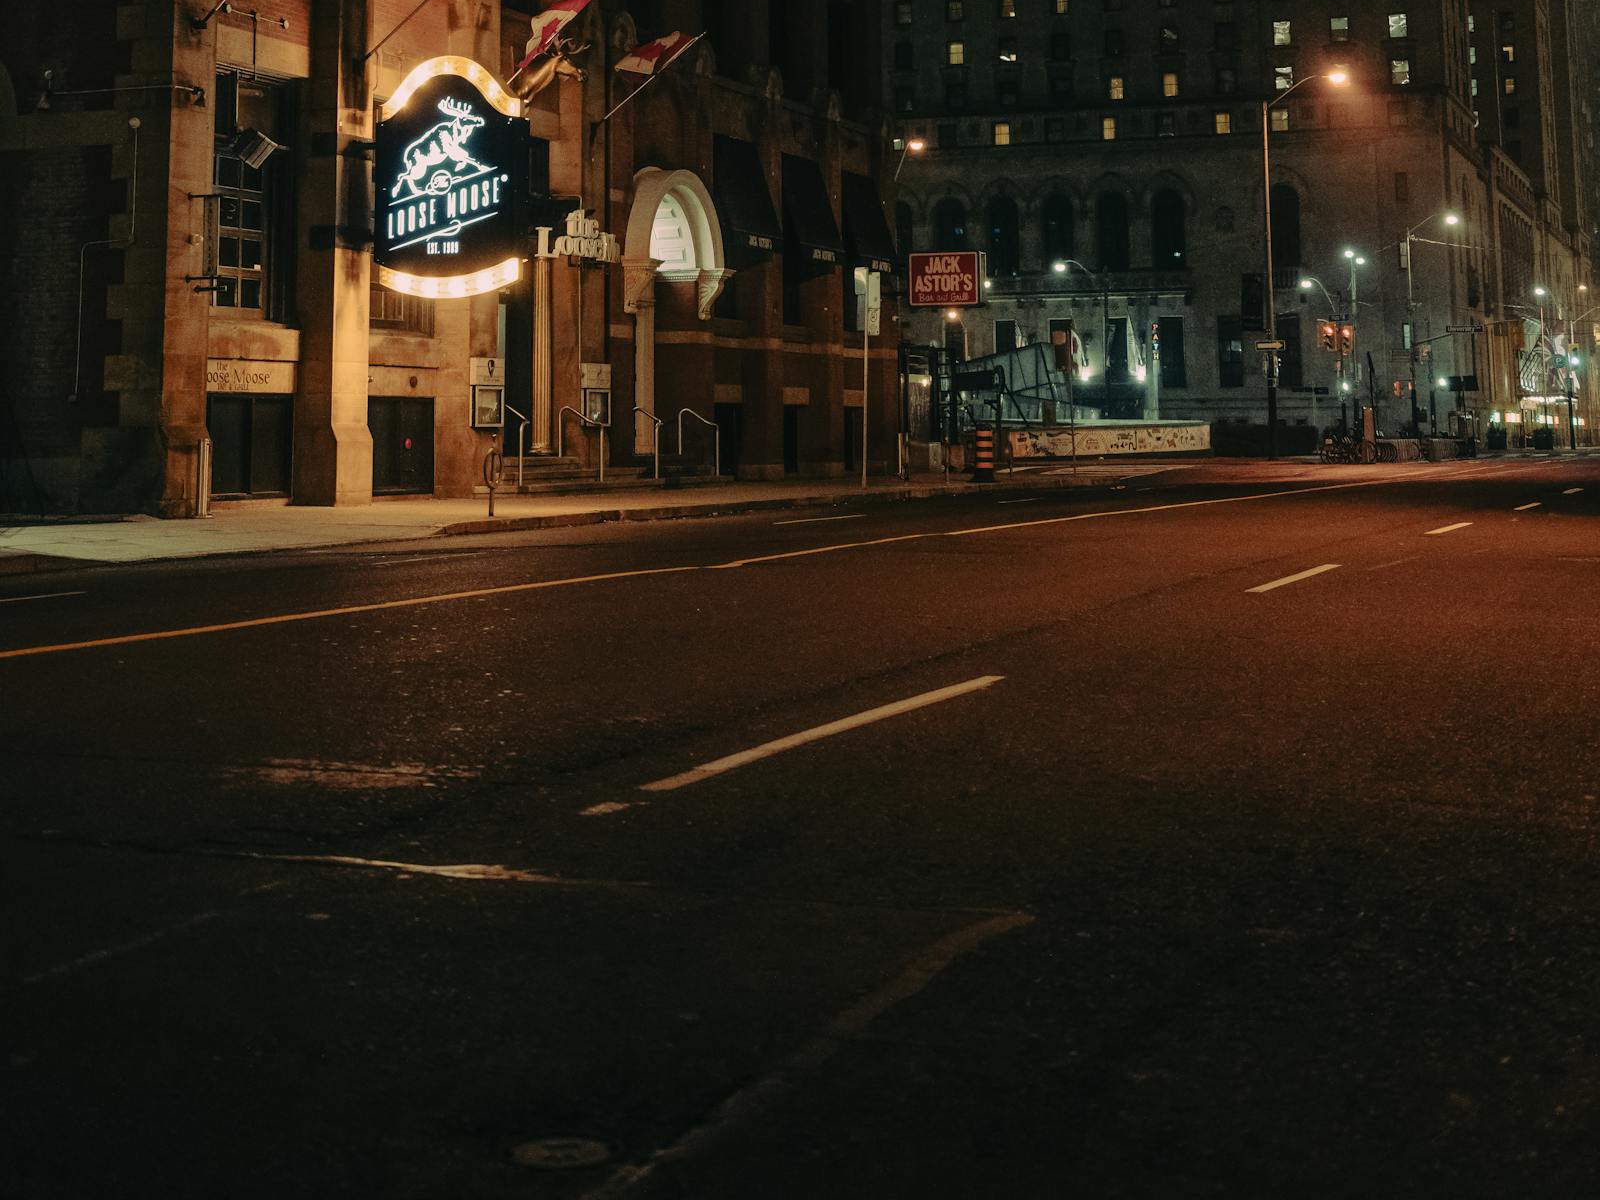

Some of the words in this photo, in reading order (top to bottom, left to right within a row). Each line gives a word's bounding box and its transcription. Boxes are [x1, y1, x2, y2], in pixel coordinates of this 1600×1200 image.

[388, 198, 437, 240] LOOSE
[565, 209, 600, 239] the
[427, 241, 441, 255] EST.
[924, 256, 961, 274] JACK
[915, 273, 973, 293] ASTOR'S
[919, 293, 934, 302] Bar
[1152, 322, 1160, 360] PATH
[207, 371, 230, 383] oose
[233, 368, 271, 385] Moose
